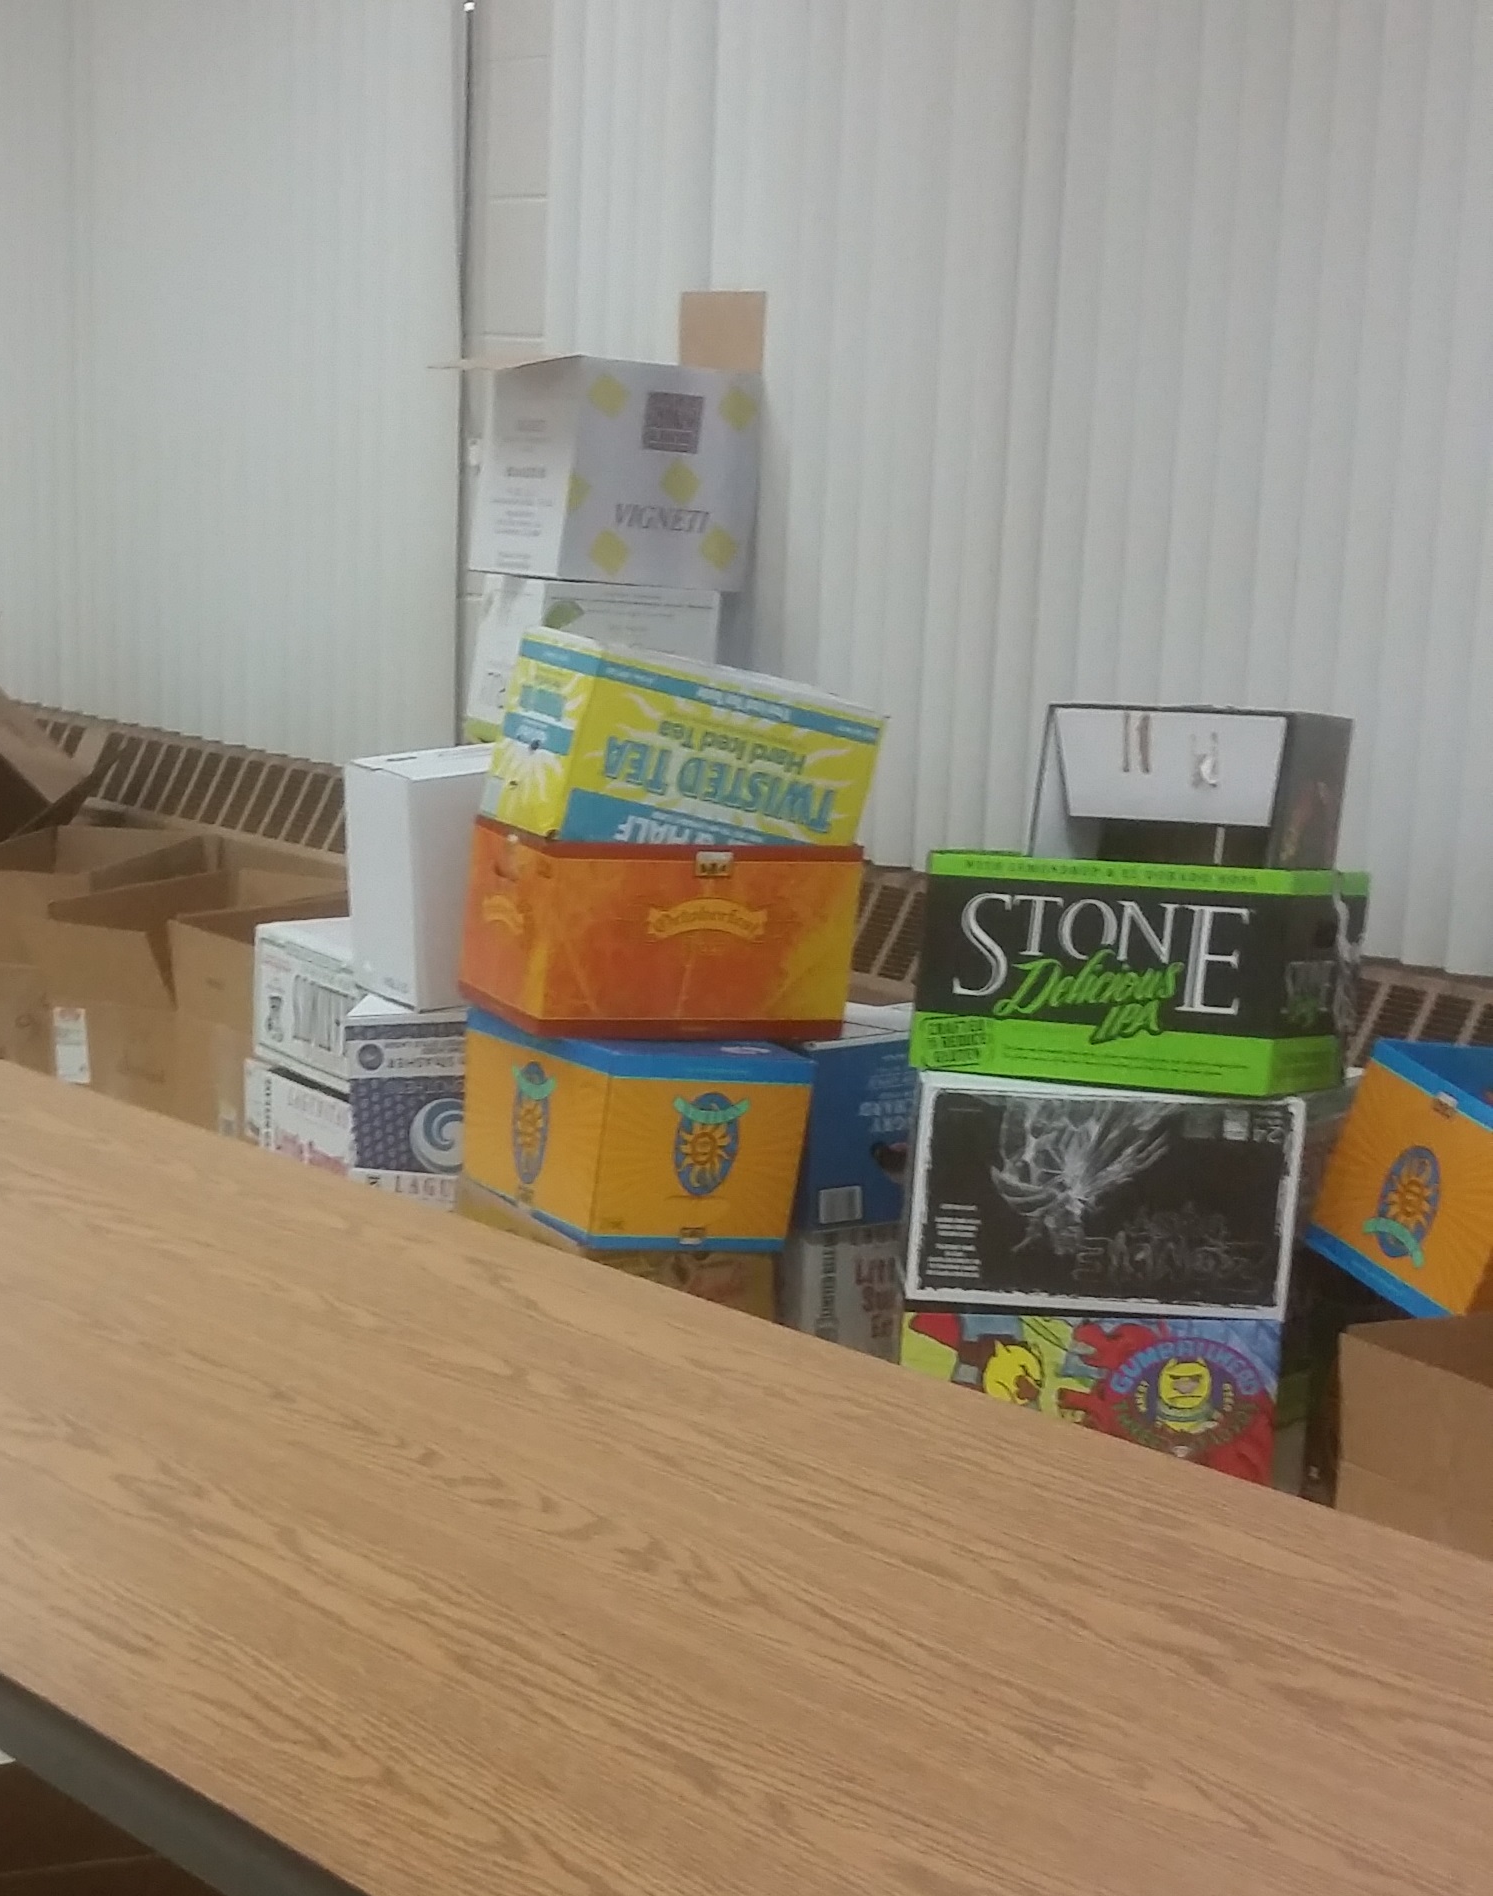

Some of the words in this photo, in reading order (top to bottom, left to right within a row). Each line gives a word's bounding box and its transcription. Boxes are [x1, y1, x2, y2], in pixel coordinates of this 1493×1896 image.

[604, 736, 672, 796] TEA
[658, 719, 695, 750] Tea
[676, 756, 836, 834] TWISTED
[952, 893, 1255, 1015] STONE
[994, 948, 1185, 1017] Delicious
[1089, 1000, 1162, 1045] IPA
